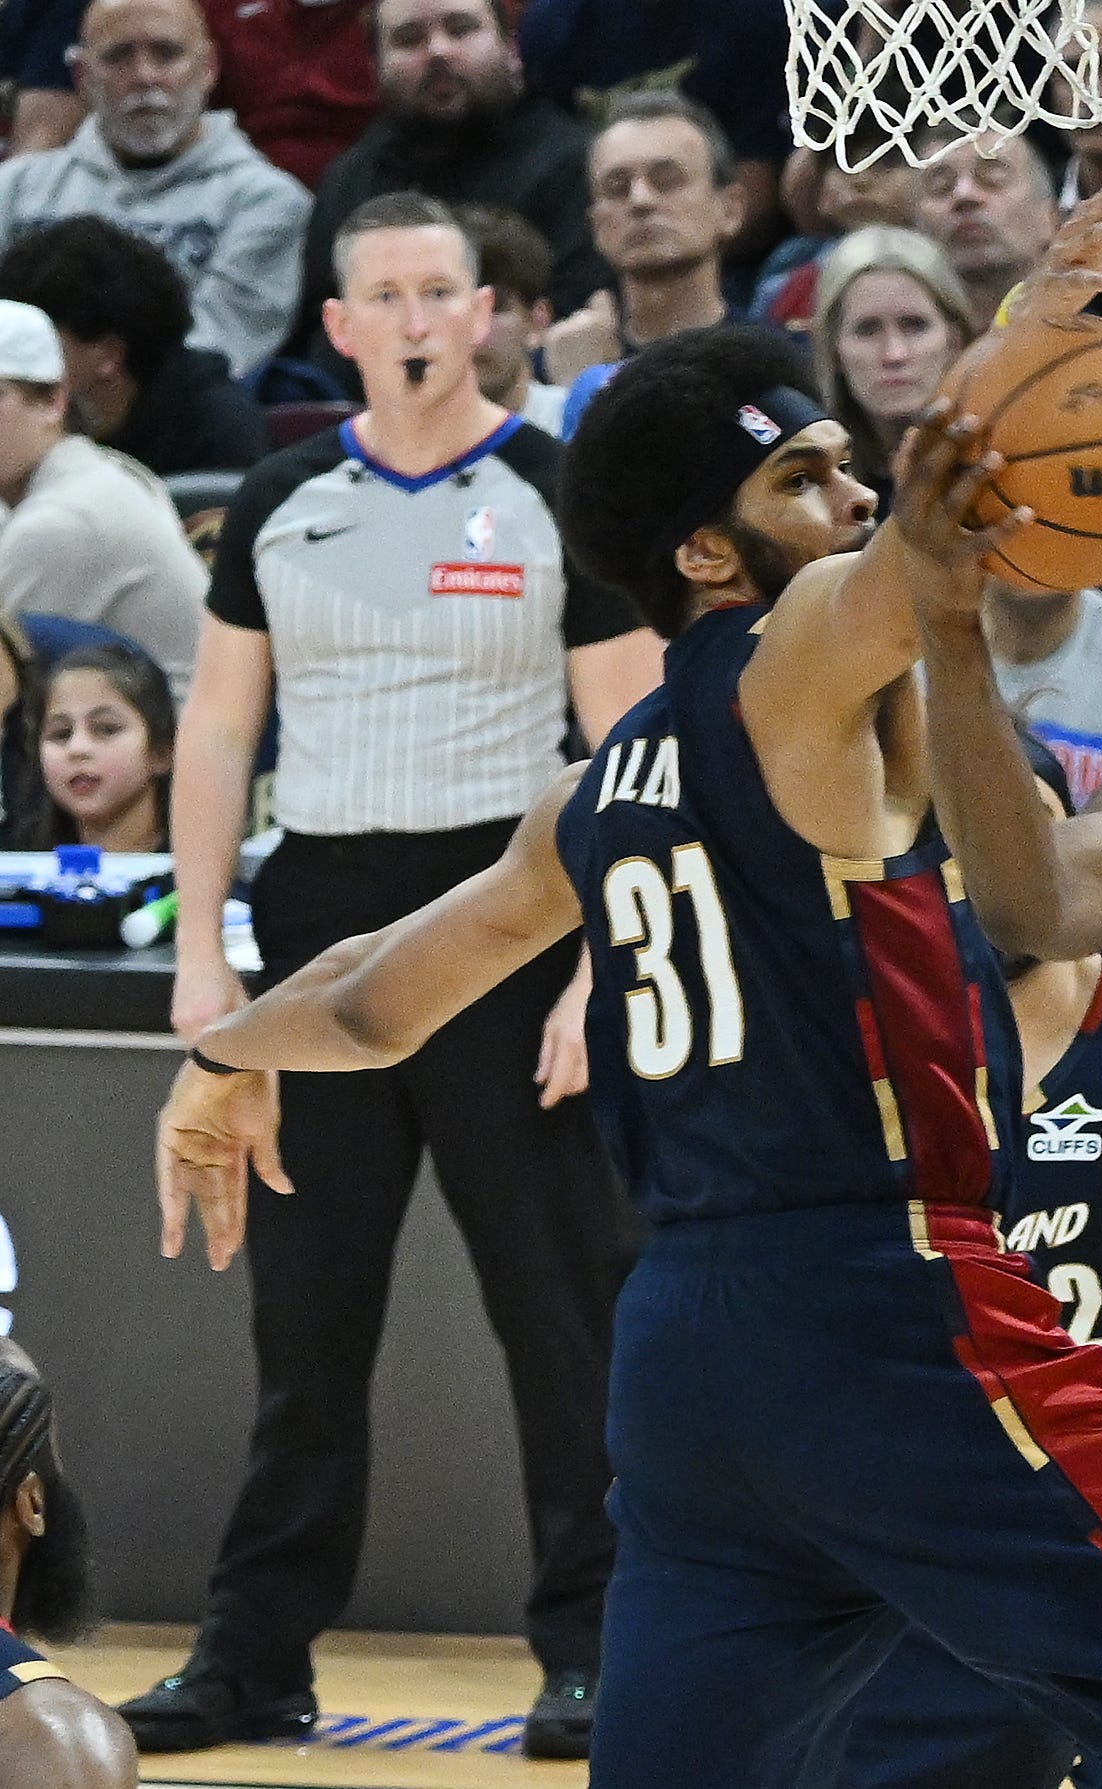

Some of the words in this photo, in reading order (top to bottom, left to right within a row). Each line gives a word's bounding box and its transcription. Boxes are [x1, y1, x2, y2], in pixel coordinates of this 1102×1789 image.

[603, 841, 746, 1081] 31
[1032, 1140, 1099, 1154] CLIFFS
[1006, 1202, 1090, 1252] AND
